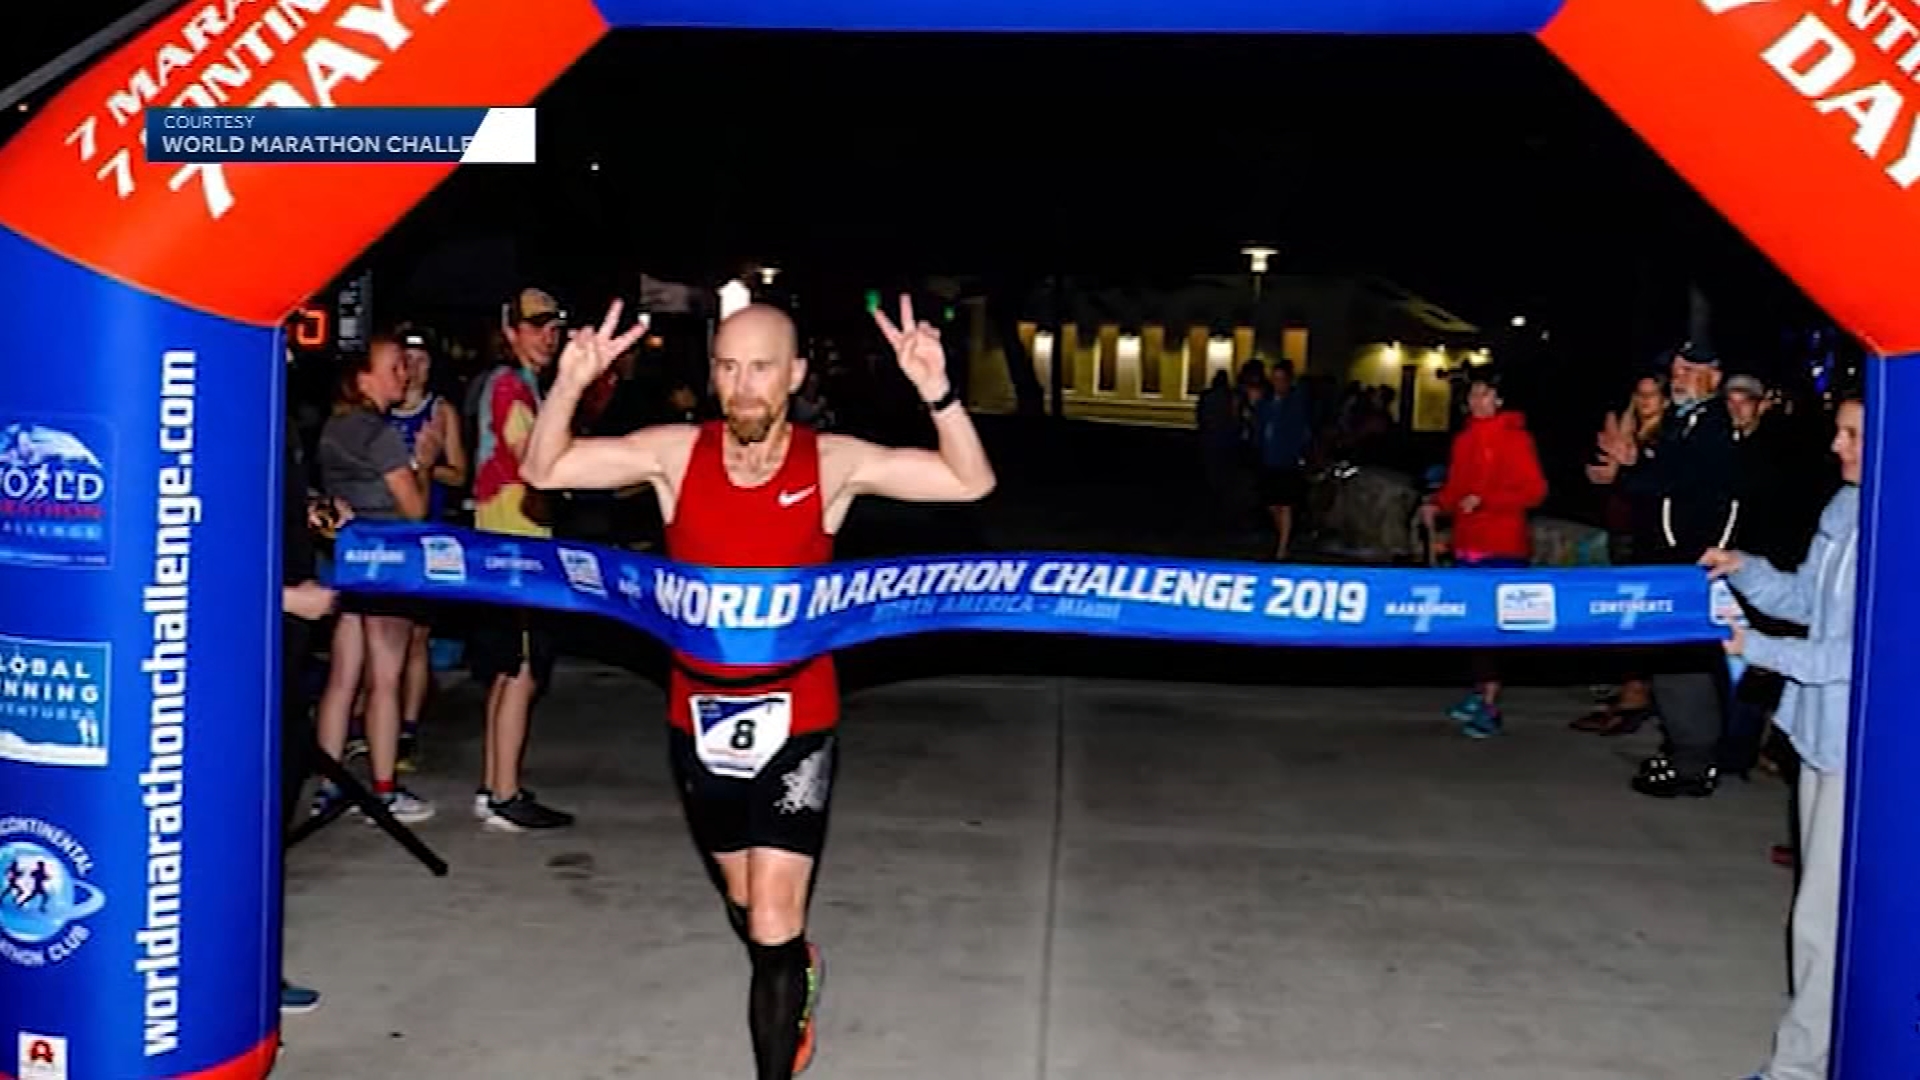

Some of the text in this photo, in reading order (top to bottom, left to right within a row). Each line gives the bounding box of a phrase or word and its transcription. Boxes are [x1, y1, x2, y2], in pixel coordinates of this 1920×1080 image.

[65, 116, 97, 161] 7
[97, 150, 134, 199] 7
[654, 567, 801, 629] WORLD
[805, 560, 1028, 620] MARATHON
[1029, 561, 1257, 613] CHALLENGE
[1264, 577, 1368, 623] 2019
[134, 349, 202, 1057] worldmarathonchallenge.com
[729, 718, 756, 750] 8
